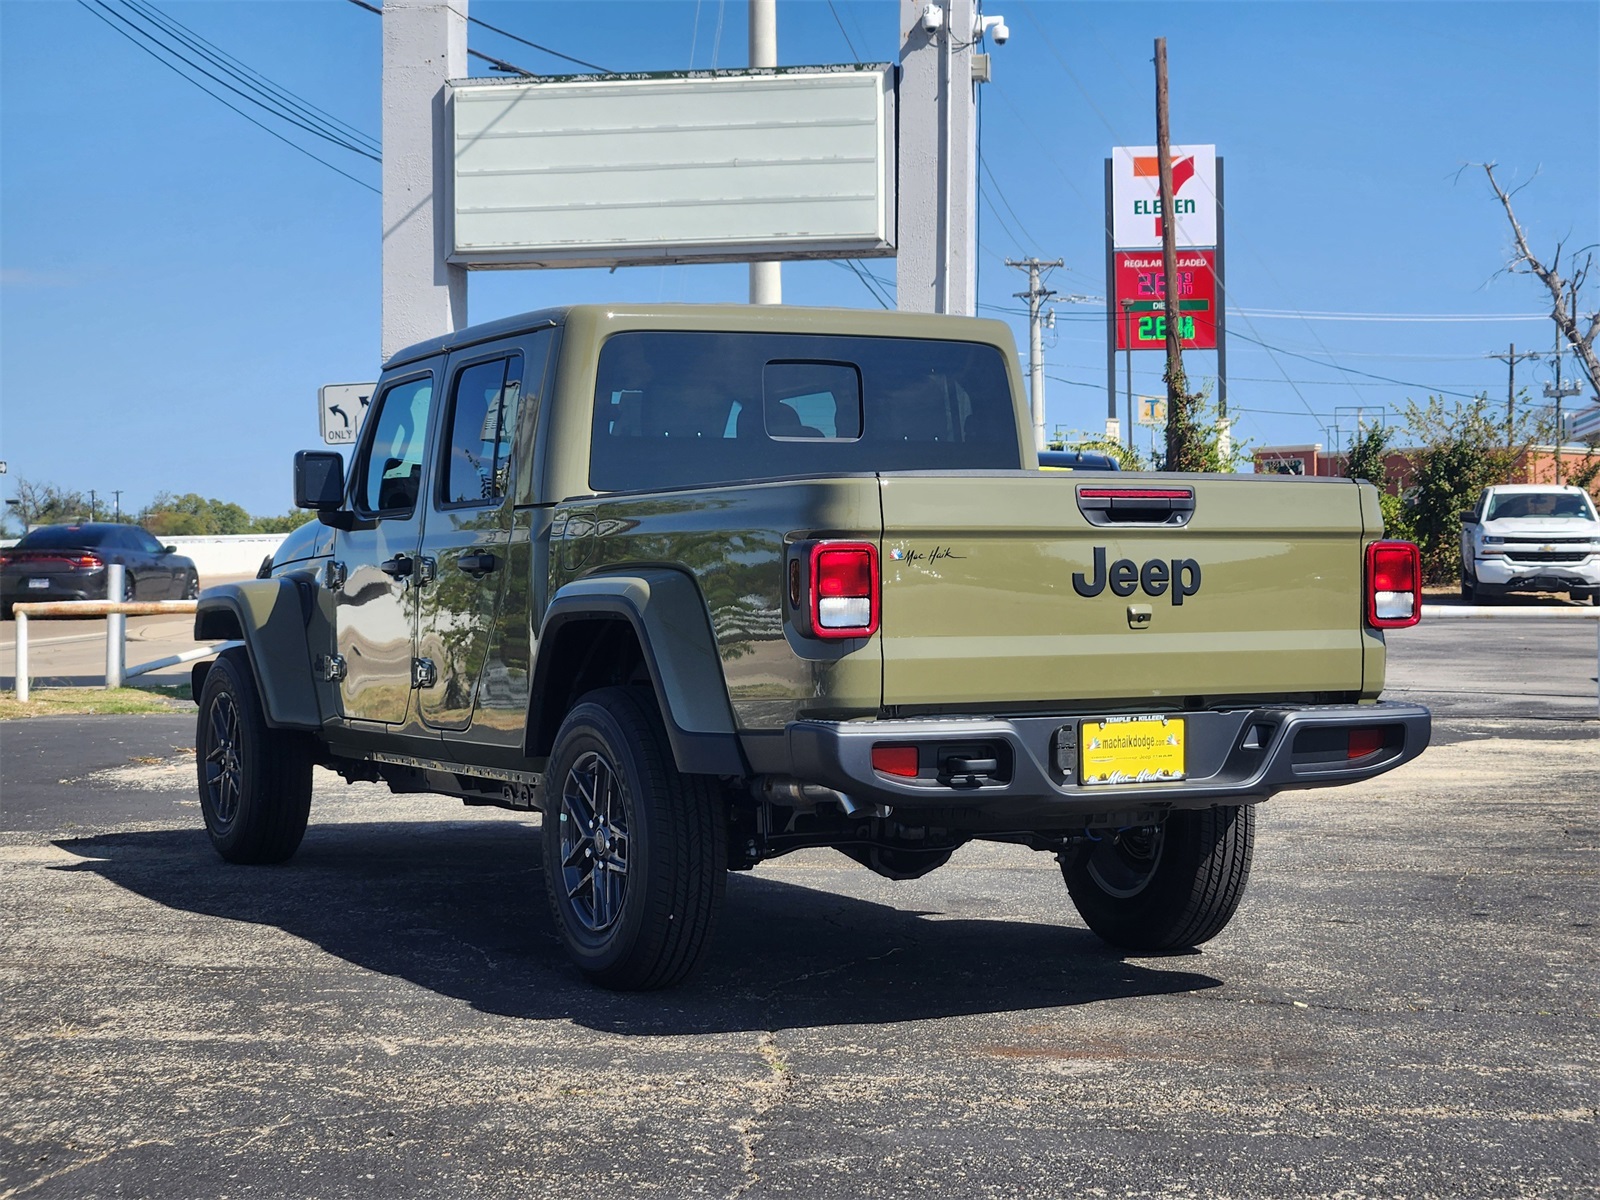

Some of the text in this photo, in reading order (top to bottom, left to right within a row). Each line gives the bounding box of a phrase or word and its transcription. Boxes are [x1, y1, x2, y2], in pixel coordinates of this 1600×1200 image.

[1124, 258, 1207, 268] REGULAR LEADED
[328, 430, 353, 440] ONLY
[902, 546, 967, 566] Mac Haik
[1071, 546, 1202, 606] Jeep
[1105, 714, 1165, 724] TEMPLE KILLEEN
[1102, 734, 1166, 750] machaikdodge.com
